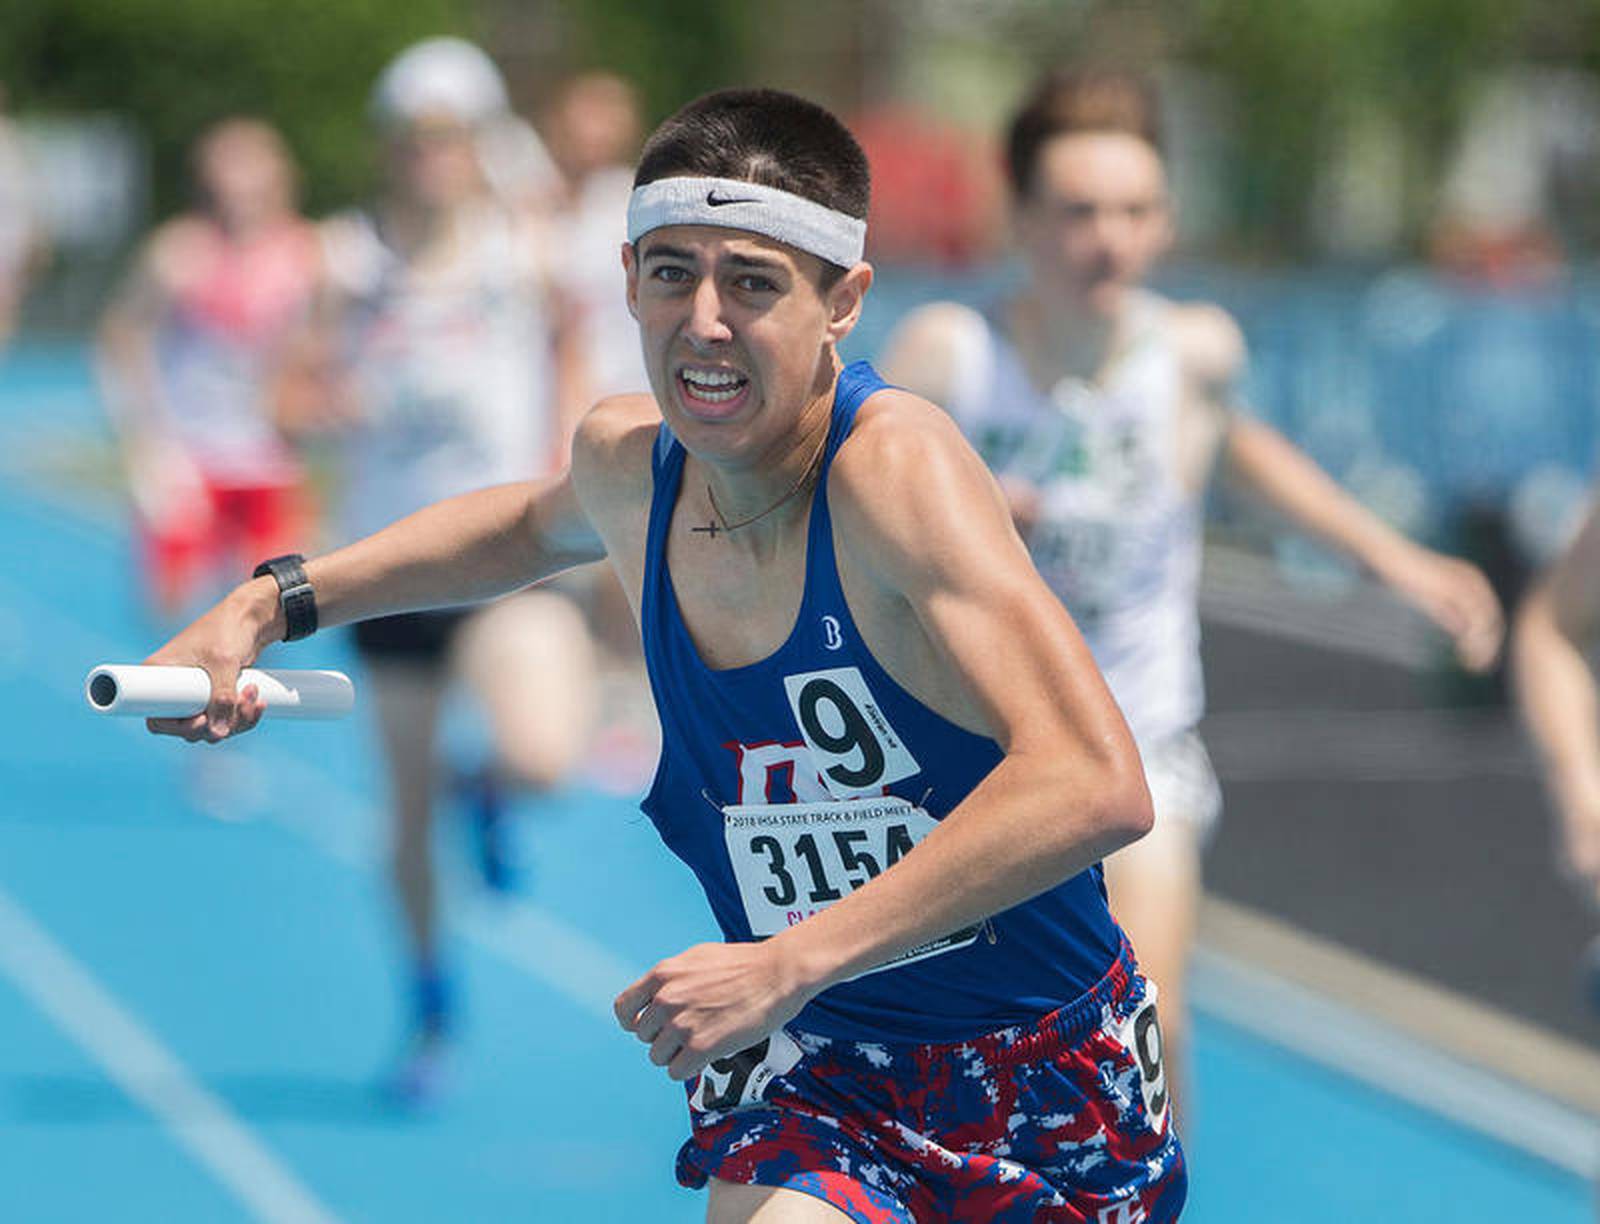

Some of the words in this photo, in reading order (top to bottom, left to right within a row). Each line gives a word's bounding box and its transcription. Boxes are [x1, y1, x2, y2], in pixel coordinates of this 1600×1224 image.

[799, 678, 886, 789] 9
[732, 815, 756, 828] 2018
[757, 814, 780, 827] IHSA
[779, 812, 809, 826] STATE
[809, 810, 843, 824] TRACK
[852, 806, 883, 821] FIELD
[884, 804, 912, 818] MEET
